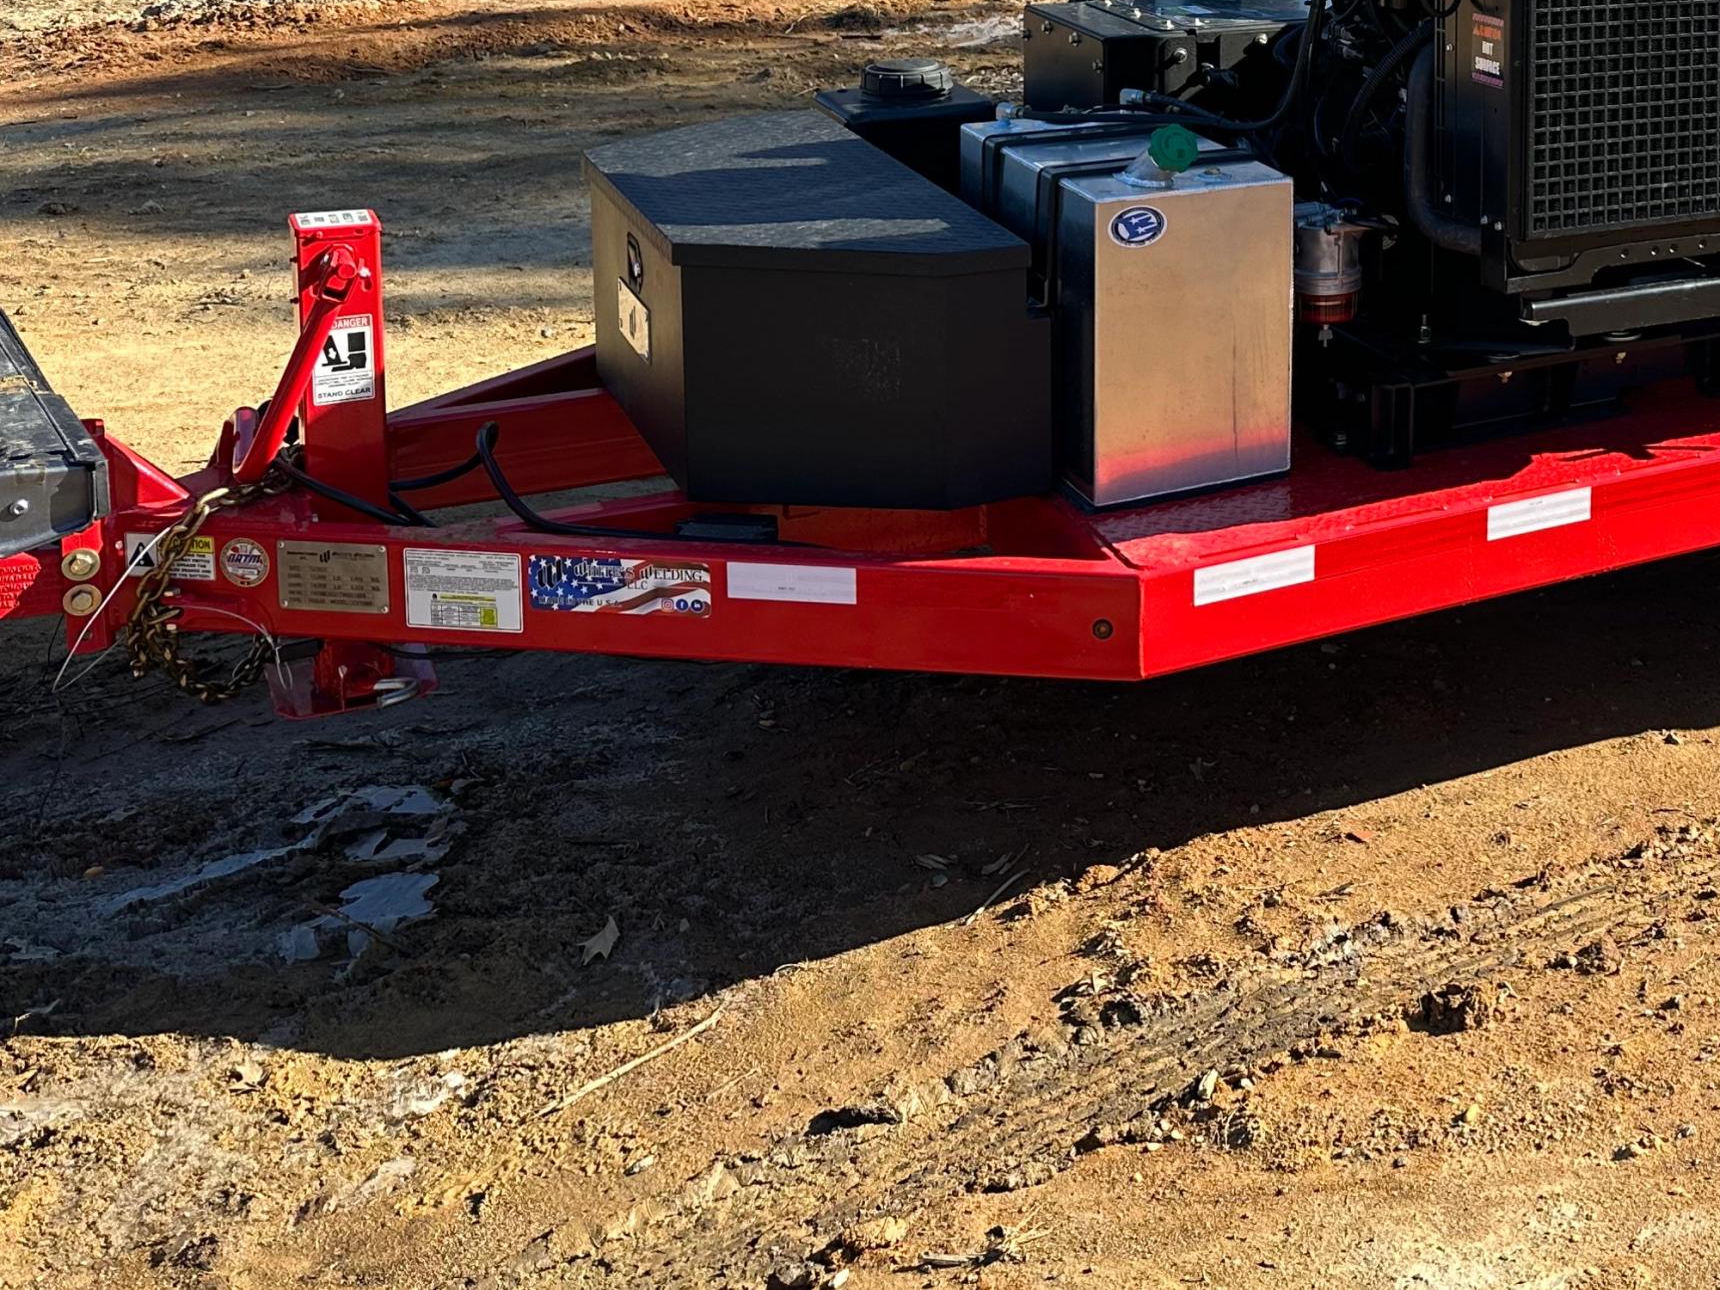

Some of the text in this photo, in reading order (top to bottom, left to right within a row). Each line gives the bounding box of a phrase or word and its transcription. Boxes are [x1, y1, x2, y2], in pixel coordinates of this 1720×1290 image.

[317, 387, 371, 399] STAND CLEAR
[626, 581, 649, 590] LLC
